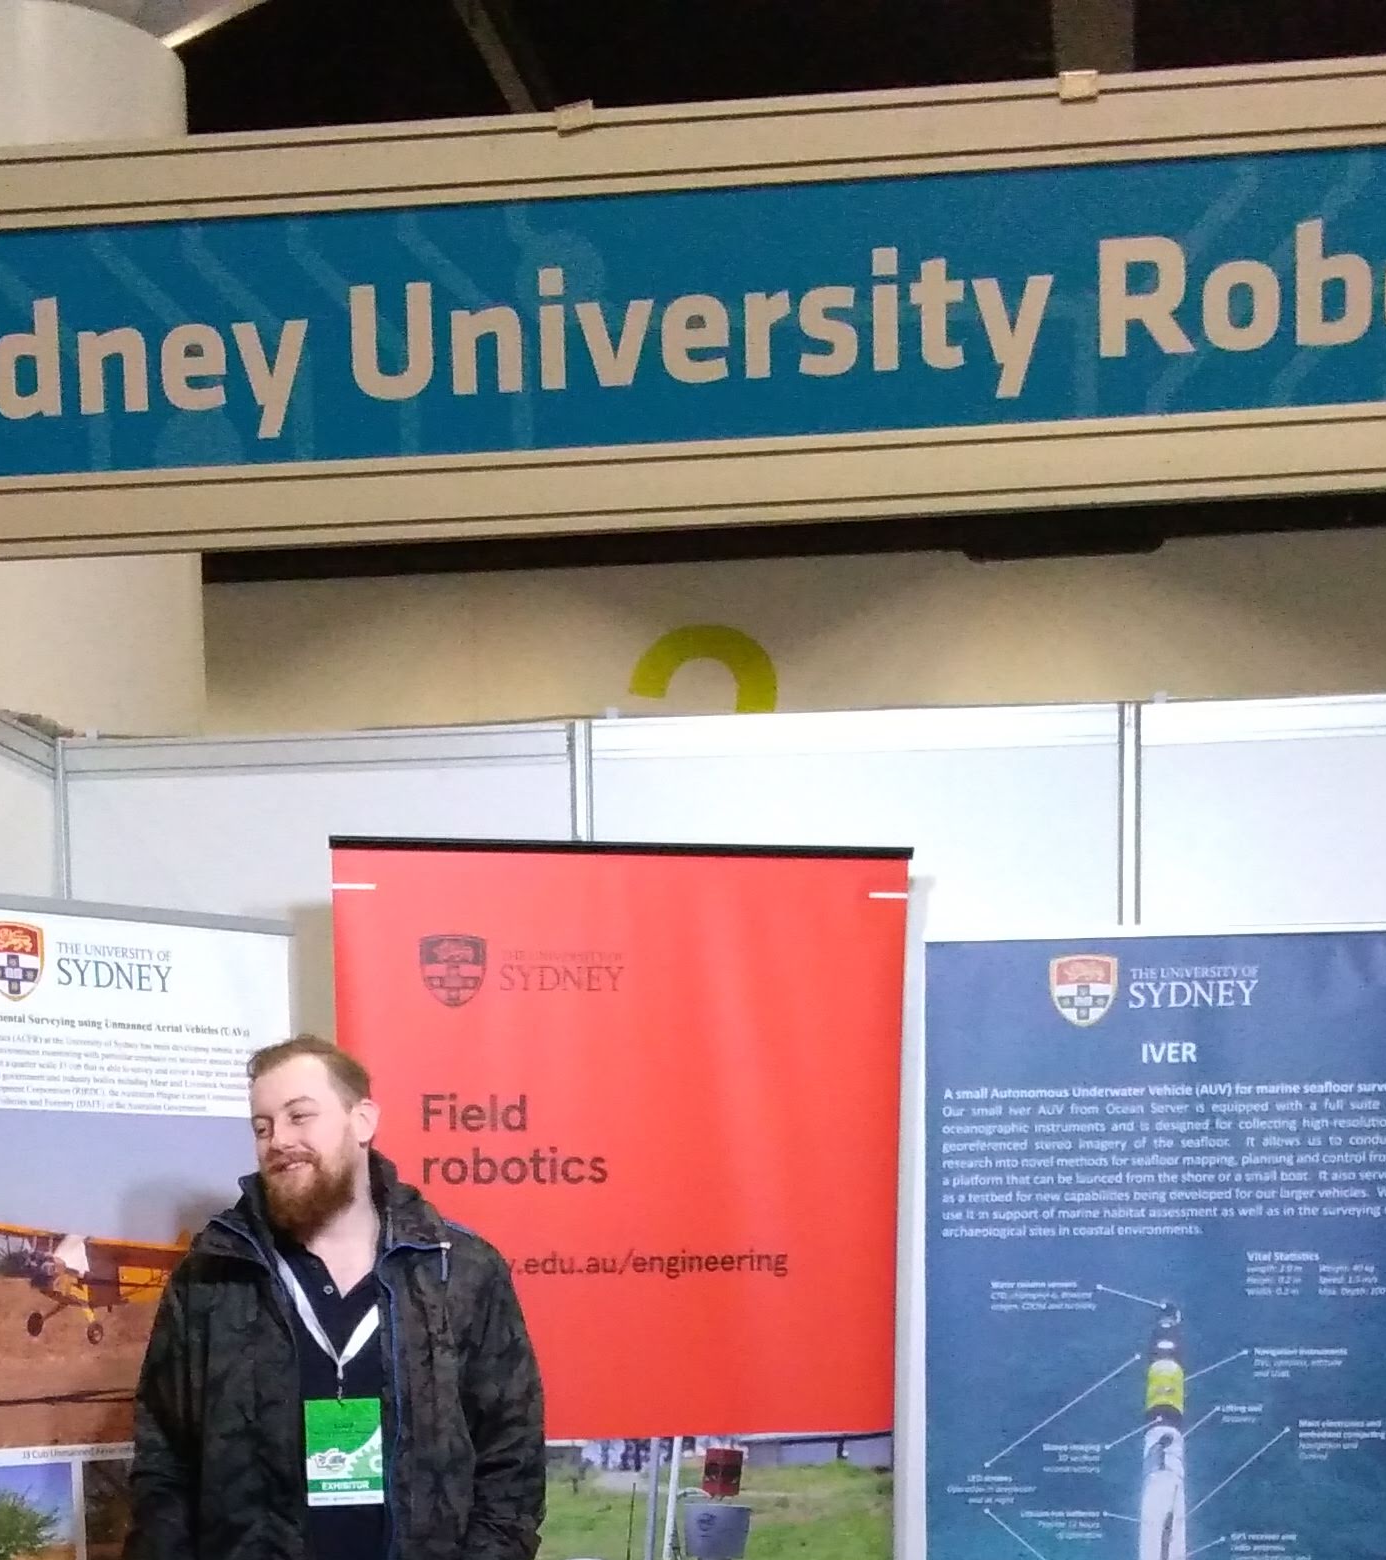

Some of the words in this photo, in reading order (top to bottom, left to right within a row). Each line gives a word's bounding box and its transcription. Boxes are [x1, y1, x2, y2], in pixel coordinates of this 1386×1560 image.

[349, 246, 1055, 399] University
[57, 958, 172, 993] SYDNEY
[500, 964, 625, 992] SYDNEY
[1130, 967, 1158, 980] THE
[1161, 966, 1238, 979] UNIVERSITY
[1241, 965, 1259, 977] OF
[1128, 979, 1259, 1009] SYDNEY
[1141, 1042, 1197, 1064] IVER
[955, 1088, 988, 1099] small
[991, 1088, 1069, 1099] Autonomous
[1072, 1086, 1145, 1098] Underwater
[1148, 1085, 1193, 1096] Vehicle
[1196, 1083, 1232, 1097] (AUV)
[1256, 1084, 1300, 1094] marine
[1303, 1081, 1353, 1093] seafloor
[421, 1093, 528, 1132] Field
[972, 1105, 1002, 1116] small
[1070, 1104, 1098, 1115] from
[1106, 1103, 1144, 1114] Ocean
[1212, 1101, 1268, 1113] equipped
[1275, 1100, 1302, 1111] with
[1324, 1099, 1343, 1110] full
[1035, 1122, 1106, 1132] instruments
[1239, 1119, 1297, 1131] collecting
[1079, 1139, 1127, 1151] imagery
[422, 1147, 609, 1185] robotics
[942, 1157, 993, 1168] research
[1022, 1157, 1054, 1167] novel
[1057, 1156, 1108, 1167] methods
[1241, 1154, 1293, 1166] planning
[1322, 1153, 1365, 1163] control
[952, 1174, 1003, 1187] platform
[1006, 1173, 1030, 1185] that
[1126, 1172, 1154, 1183] from
[1181, 1171, 1213, 1182] shore
[1245, 1170, 1277, 1182] small
[1169, 1188, 1231, 1200] developed
[1280, 1188, 1314, 1201] larger
[992, 1209, 1038, 1221] support
[1058, 1209, 1100, 1218] marine
[1238, 1205, 1262, 1216] well
[1322, 1204, 1381, 1217] surveying
[1029, 1224, 1055, 1236] sites
[1073, 1224, 1113, 1236] coastal
